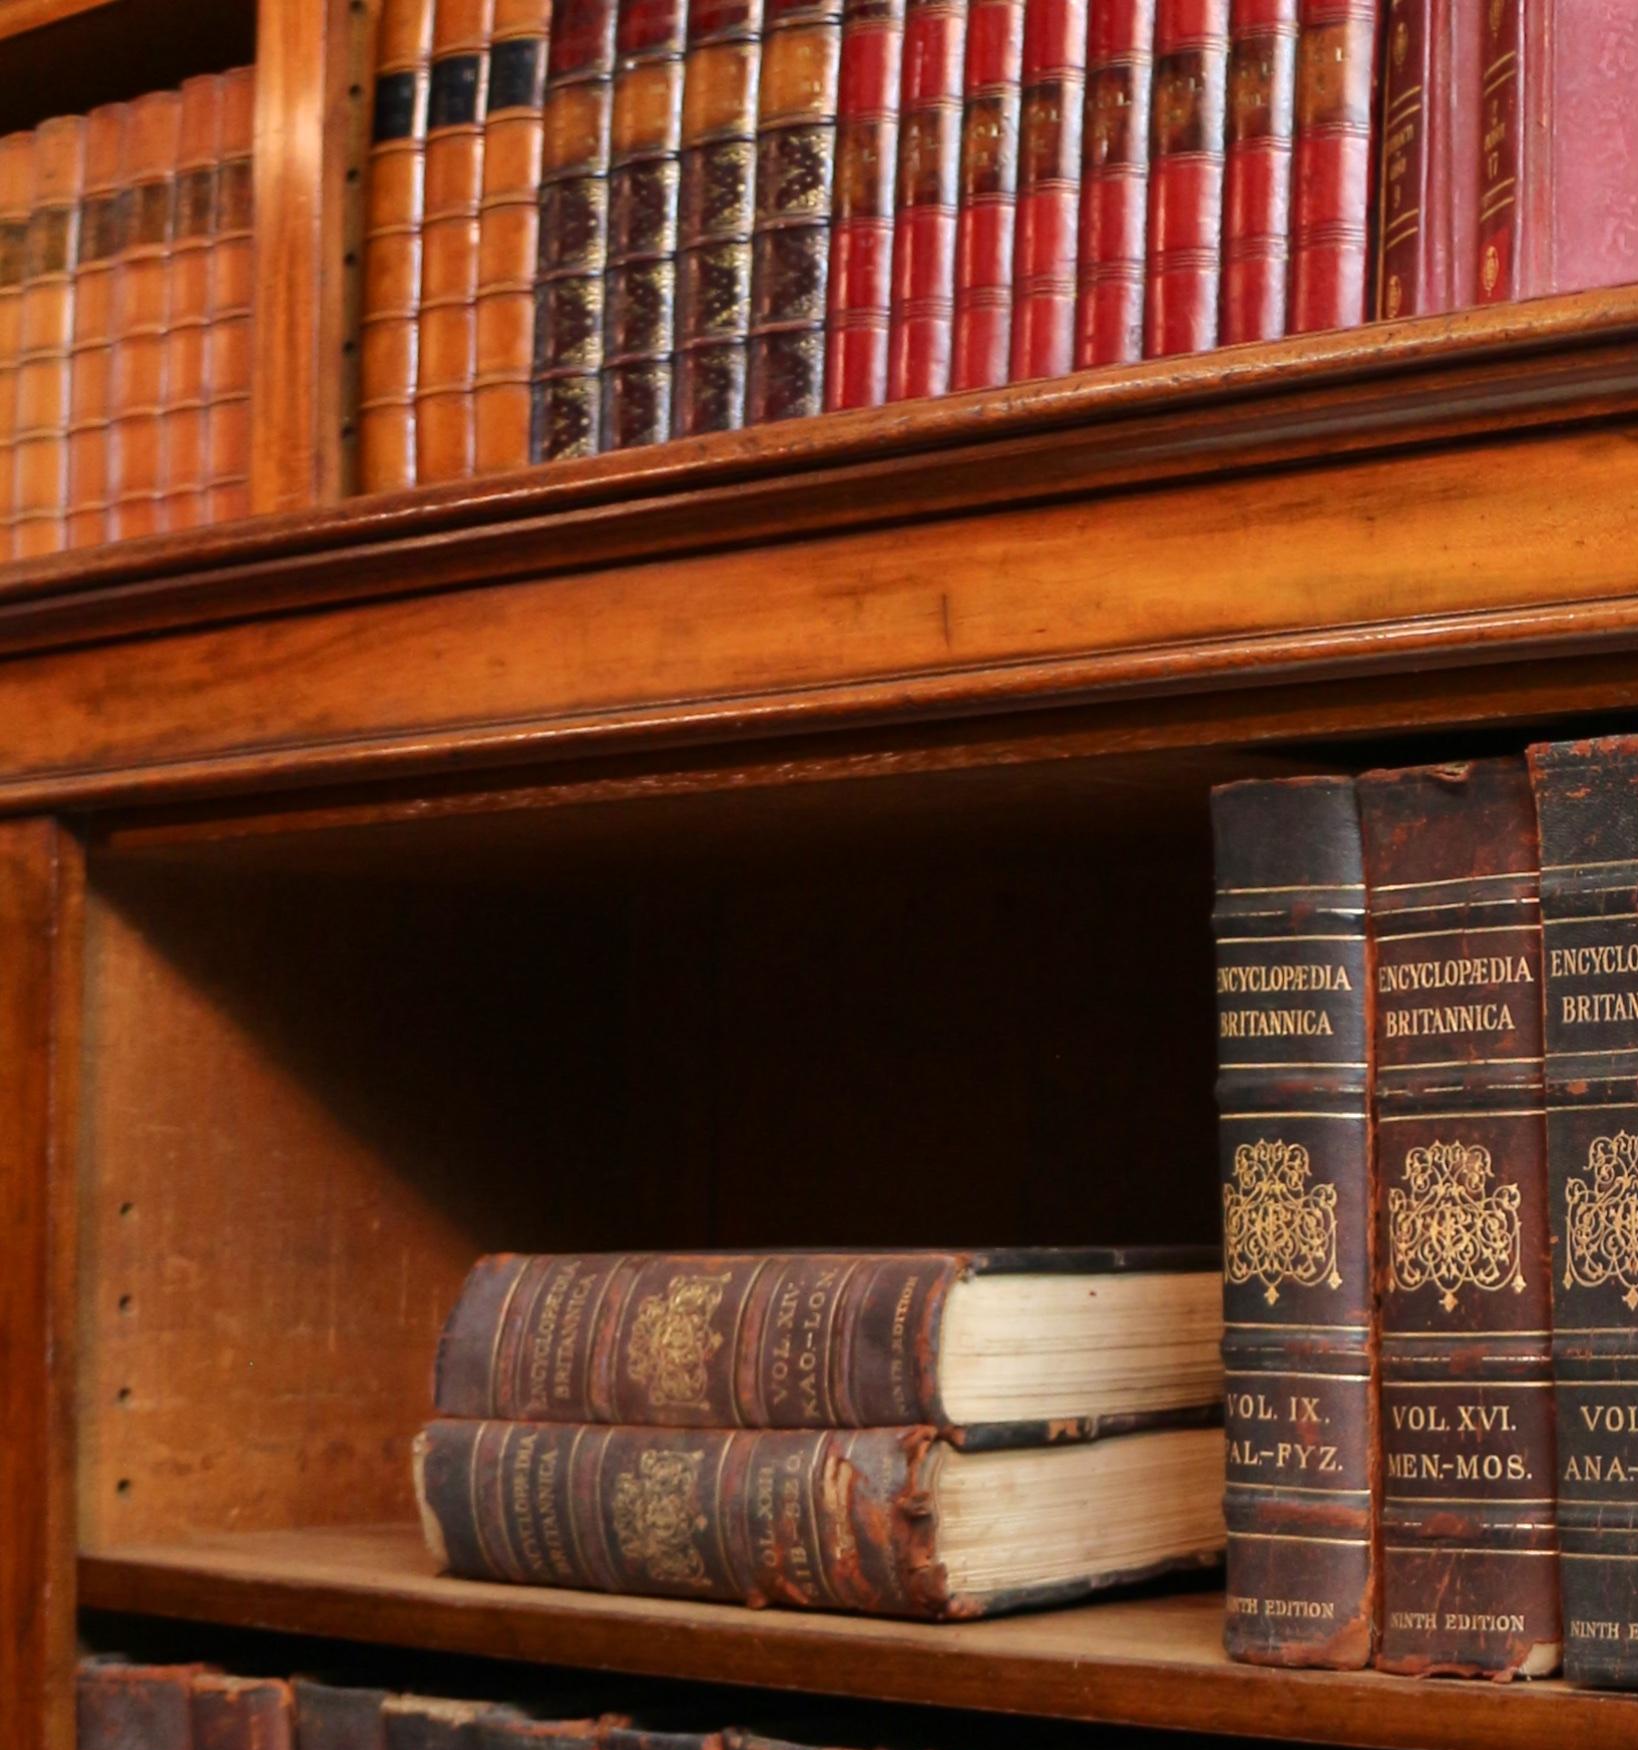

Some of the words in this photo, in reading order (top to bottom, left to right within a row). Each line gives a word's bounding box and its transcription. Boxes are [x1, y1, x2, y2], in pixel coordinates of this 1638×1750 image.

[1379, 956, 1535, 995] ENCYCLOPÆDIA
[1220, 1008, 1334, 1038] BRITANNICA
[1385, 1004, 1516, 1039] BRITANNICA
[1228, 1393, 1278, 1420] VOL.
[1289, 1396, 1331, 1424] IX.
[1391, 1404, 1451, 1433] VOL.
[1456, 1405, 1518, 1433] XVI.
[1228, 1440, 1344, 1472] AL.-FYZ.
[512, 1430, 544, 1571] NCYCLOPÆDIA
[1264, 1599, 1335, 1620] EDITION
[1445, 1613, 1526, 1633] EDITION
[1569, 1619, 1620, 1641] NINTH
